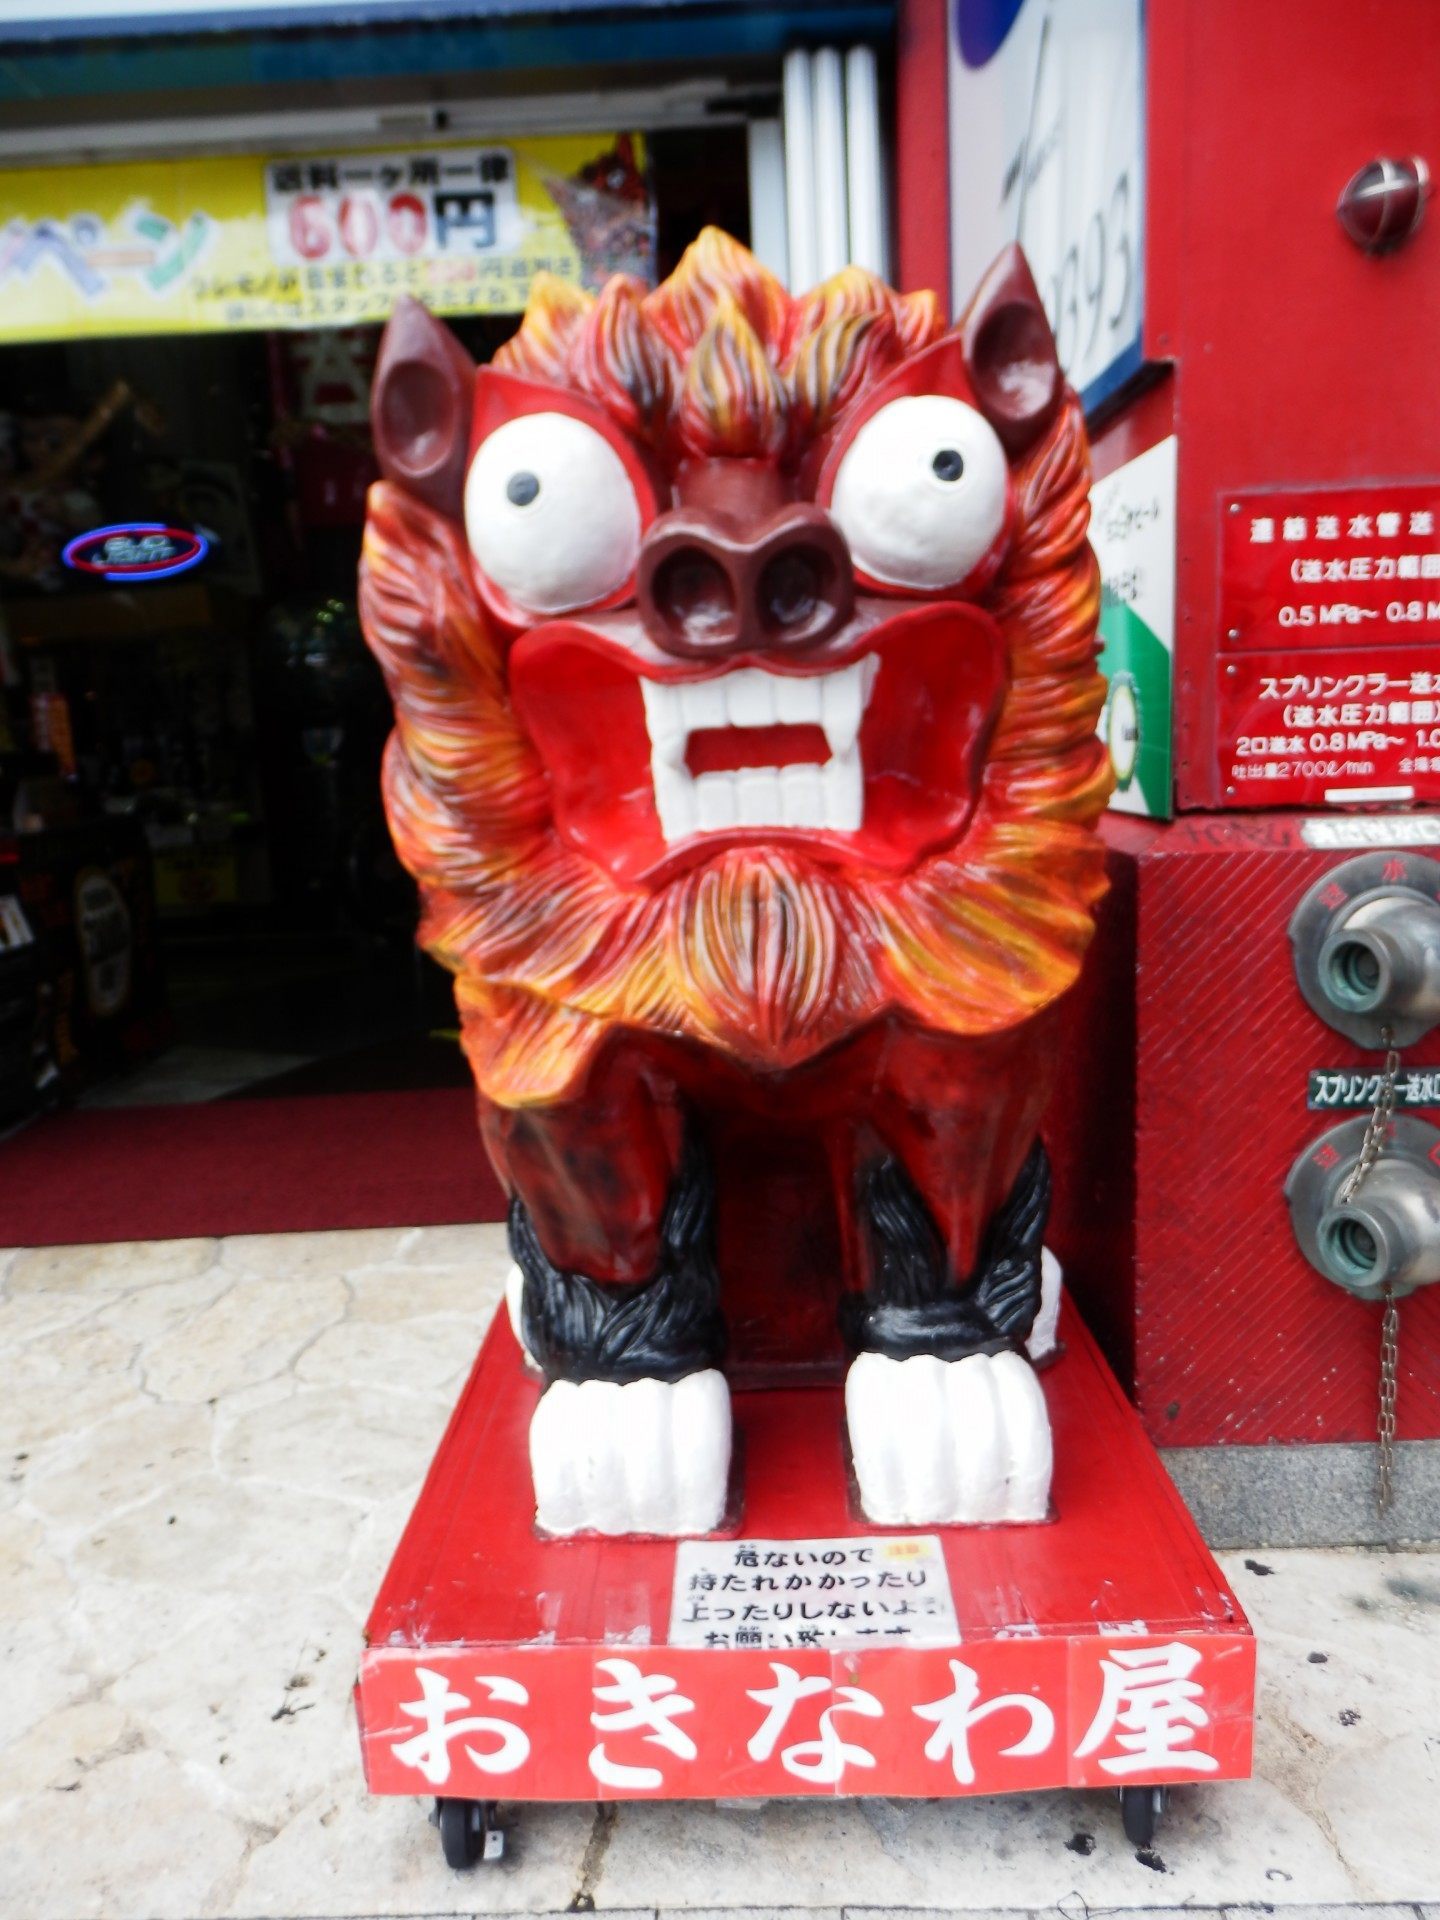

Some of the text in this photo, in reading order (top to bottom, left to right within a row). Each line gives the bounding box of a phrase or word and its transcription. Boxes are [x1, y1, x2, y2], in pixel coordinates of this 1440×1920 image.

[290, 191, 496, 261] 600円
[689, 1570, 927, 1591] 持たれかかったり
[733, 1549, 874, 1568] 危ないので
[391, 1644, 1219, 1786] おきなわ屋
